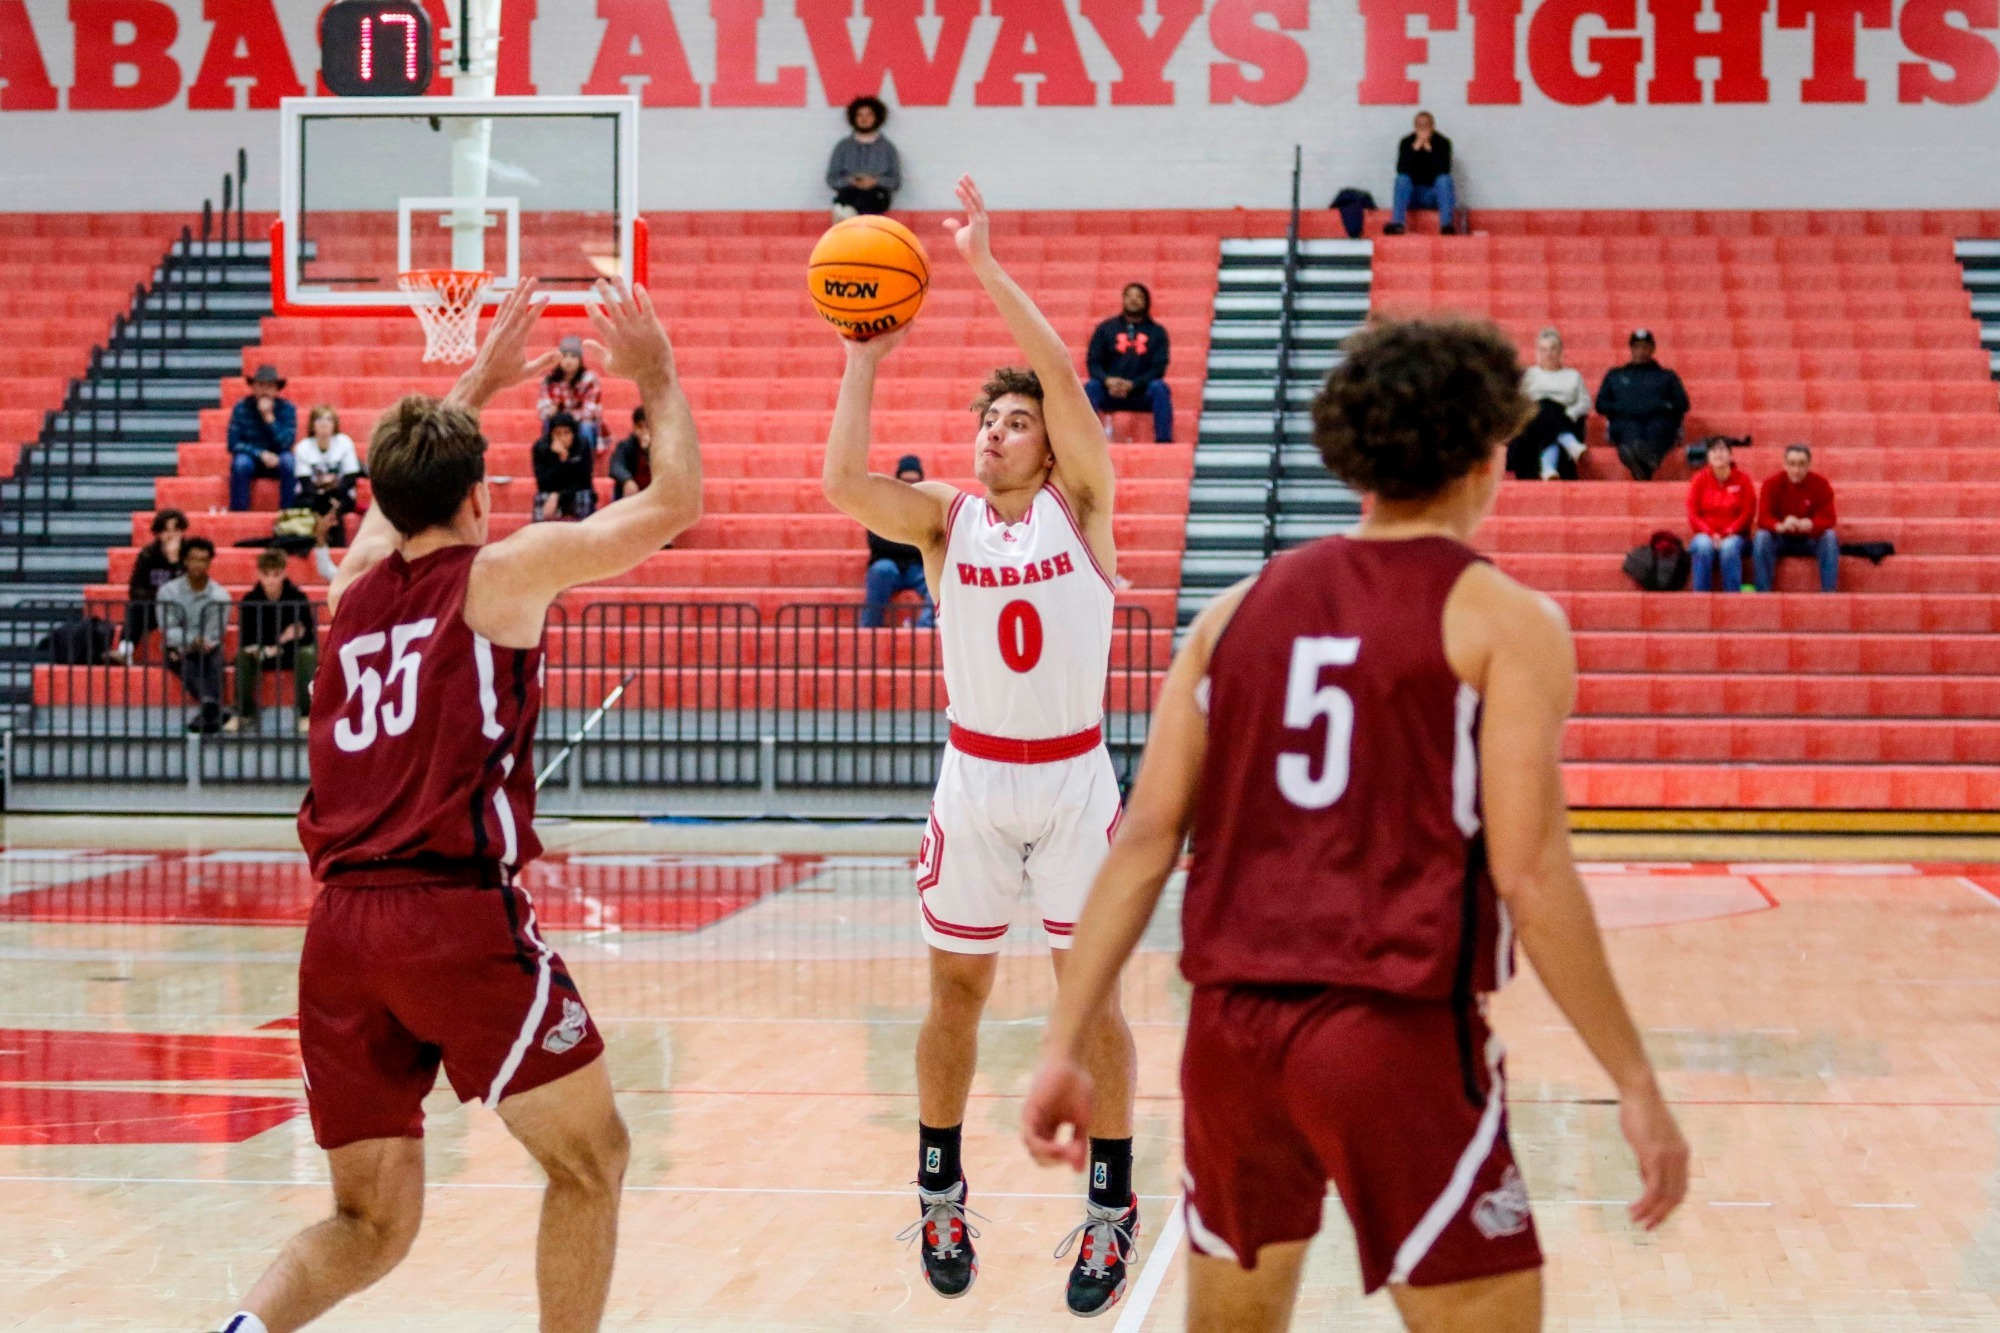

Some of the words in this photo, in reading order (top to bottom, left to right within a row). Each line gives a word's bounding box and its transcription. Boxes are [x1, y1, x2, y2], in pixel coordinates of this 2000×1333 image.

[360, 13, 418, 81] 17
[580, 0, 1309, 108] ALWAYS
[1358, 0, 2000, 106] FIGHTS
[824, 279, 879, 299] NCAA
[957, 551, 1074, 588] WABASH
[998, 599, 1043, 673] 0
[334, 617, 438, 752] 55
[1276, 636, 1362, 810] 5
